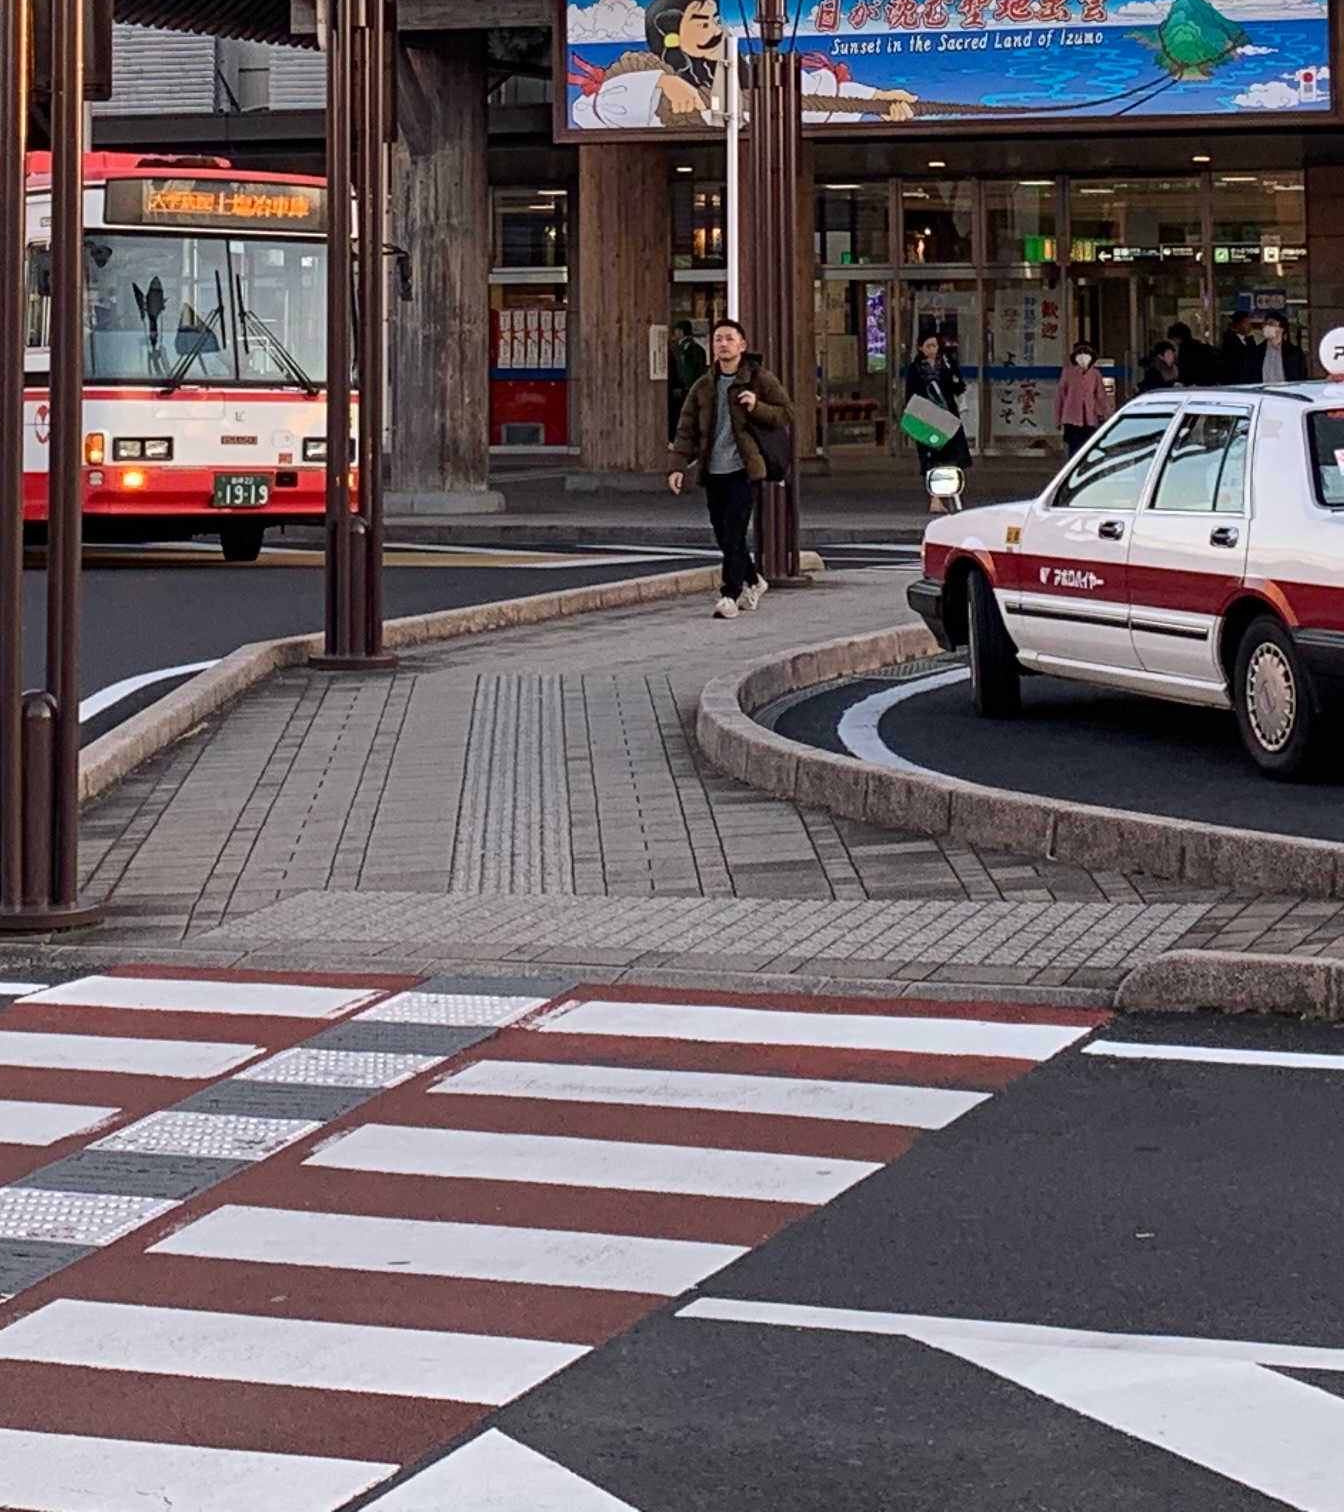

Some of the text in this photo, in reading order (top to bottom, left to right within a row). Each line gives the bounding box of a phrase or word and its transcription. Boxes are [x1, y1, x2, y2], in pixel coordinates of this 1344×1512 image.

[831, 29, 1104, 56] Sunset in the Sacred Land of Izumo
[226, 484, 269, 505] 19-19
